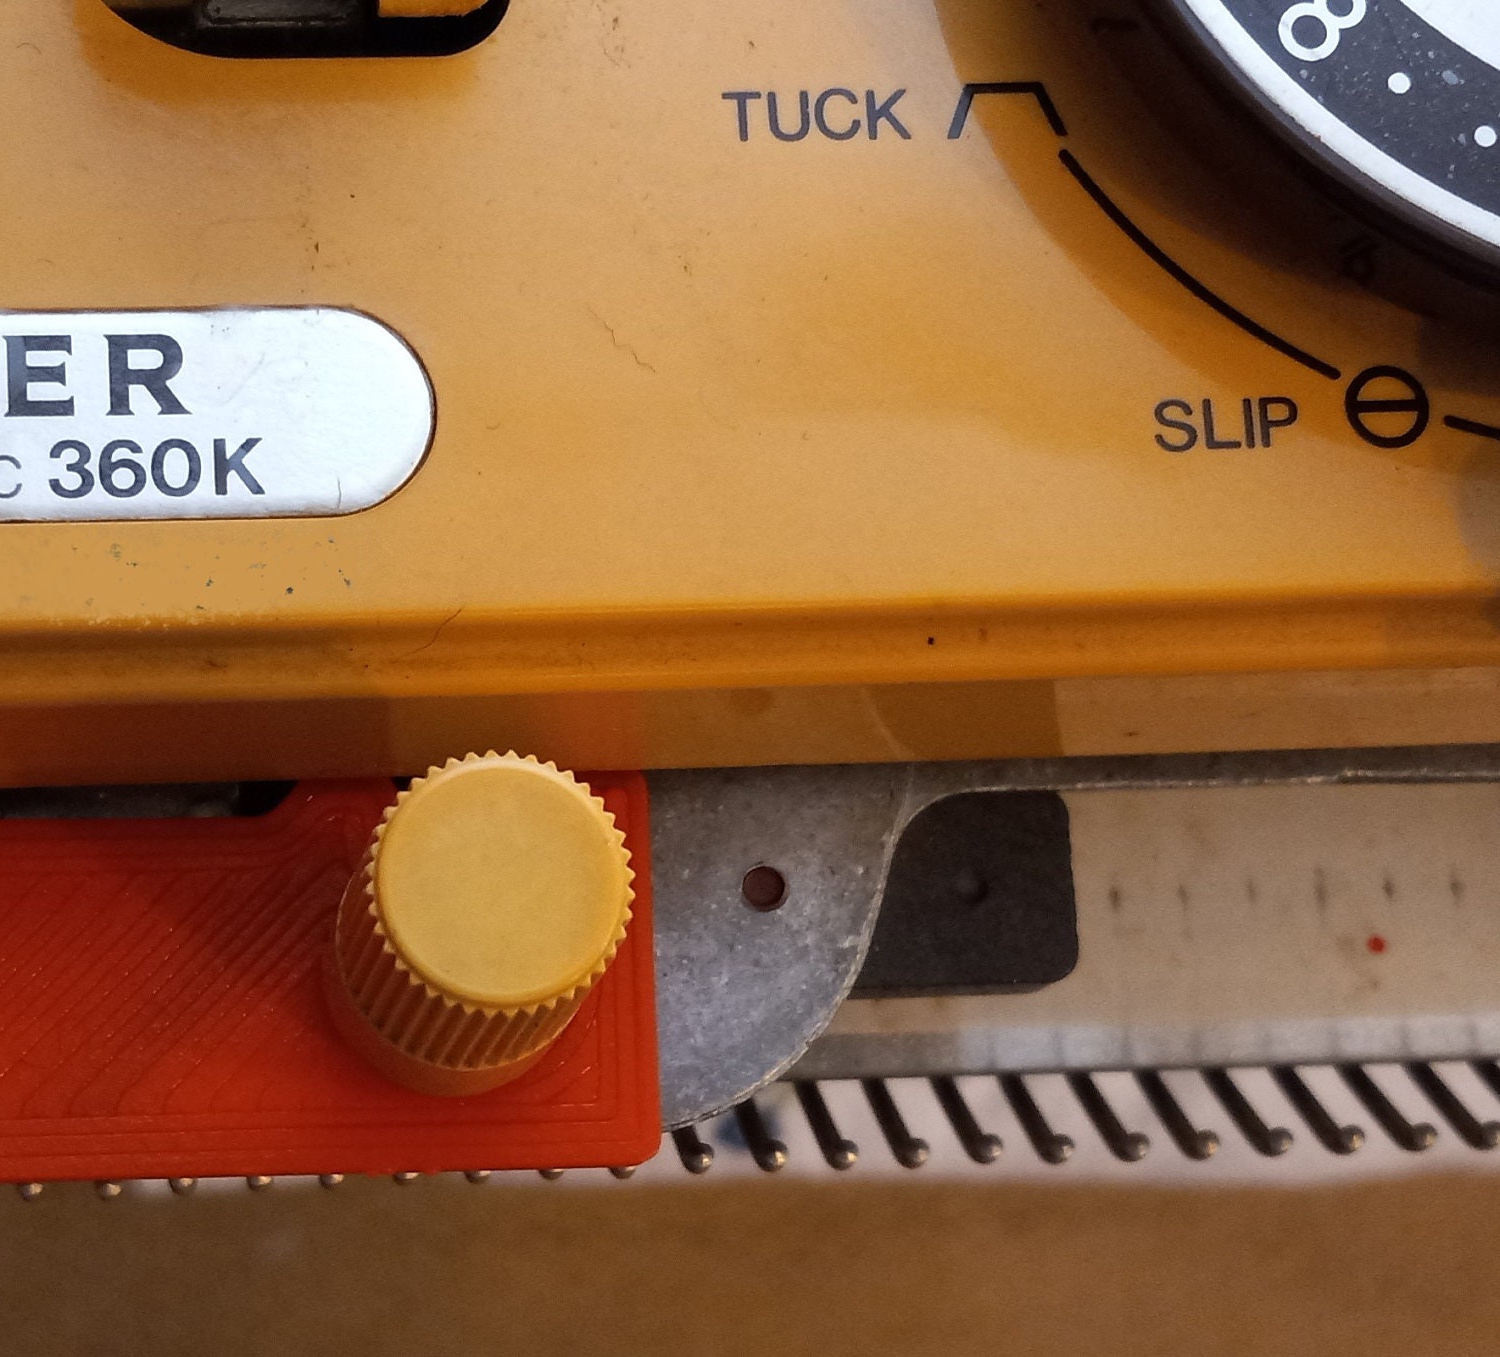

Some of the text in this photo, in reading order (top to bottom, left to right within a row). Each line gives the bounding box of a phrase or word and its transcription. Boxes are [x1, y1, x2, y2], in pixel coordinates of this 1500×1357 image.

[720, 88, 912, 142] TUCK
[1152, 396, 1299, 453] SLIP
[48, 438, 266, 499] 360K
